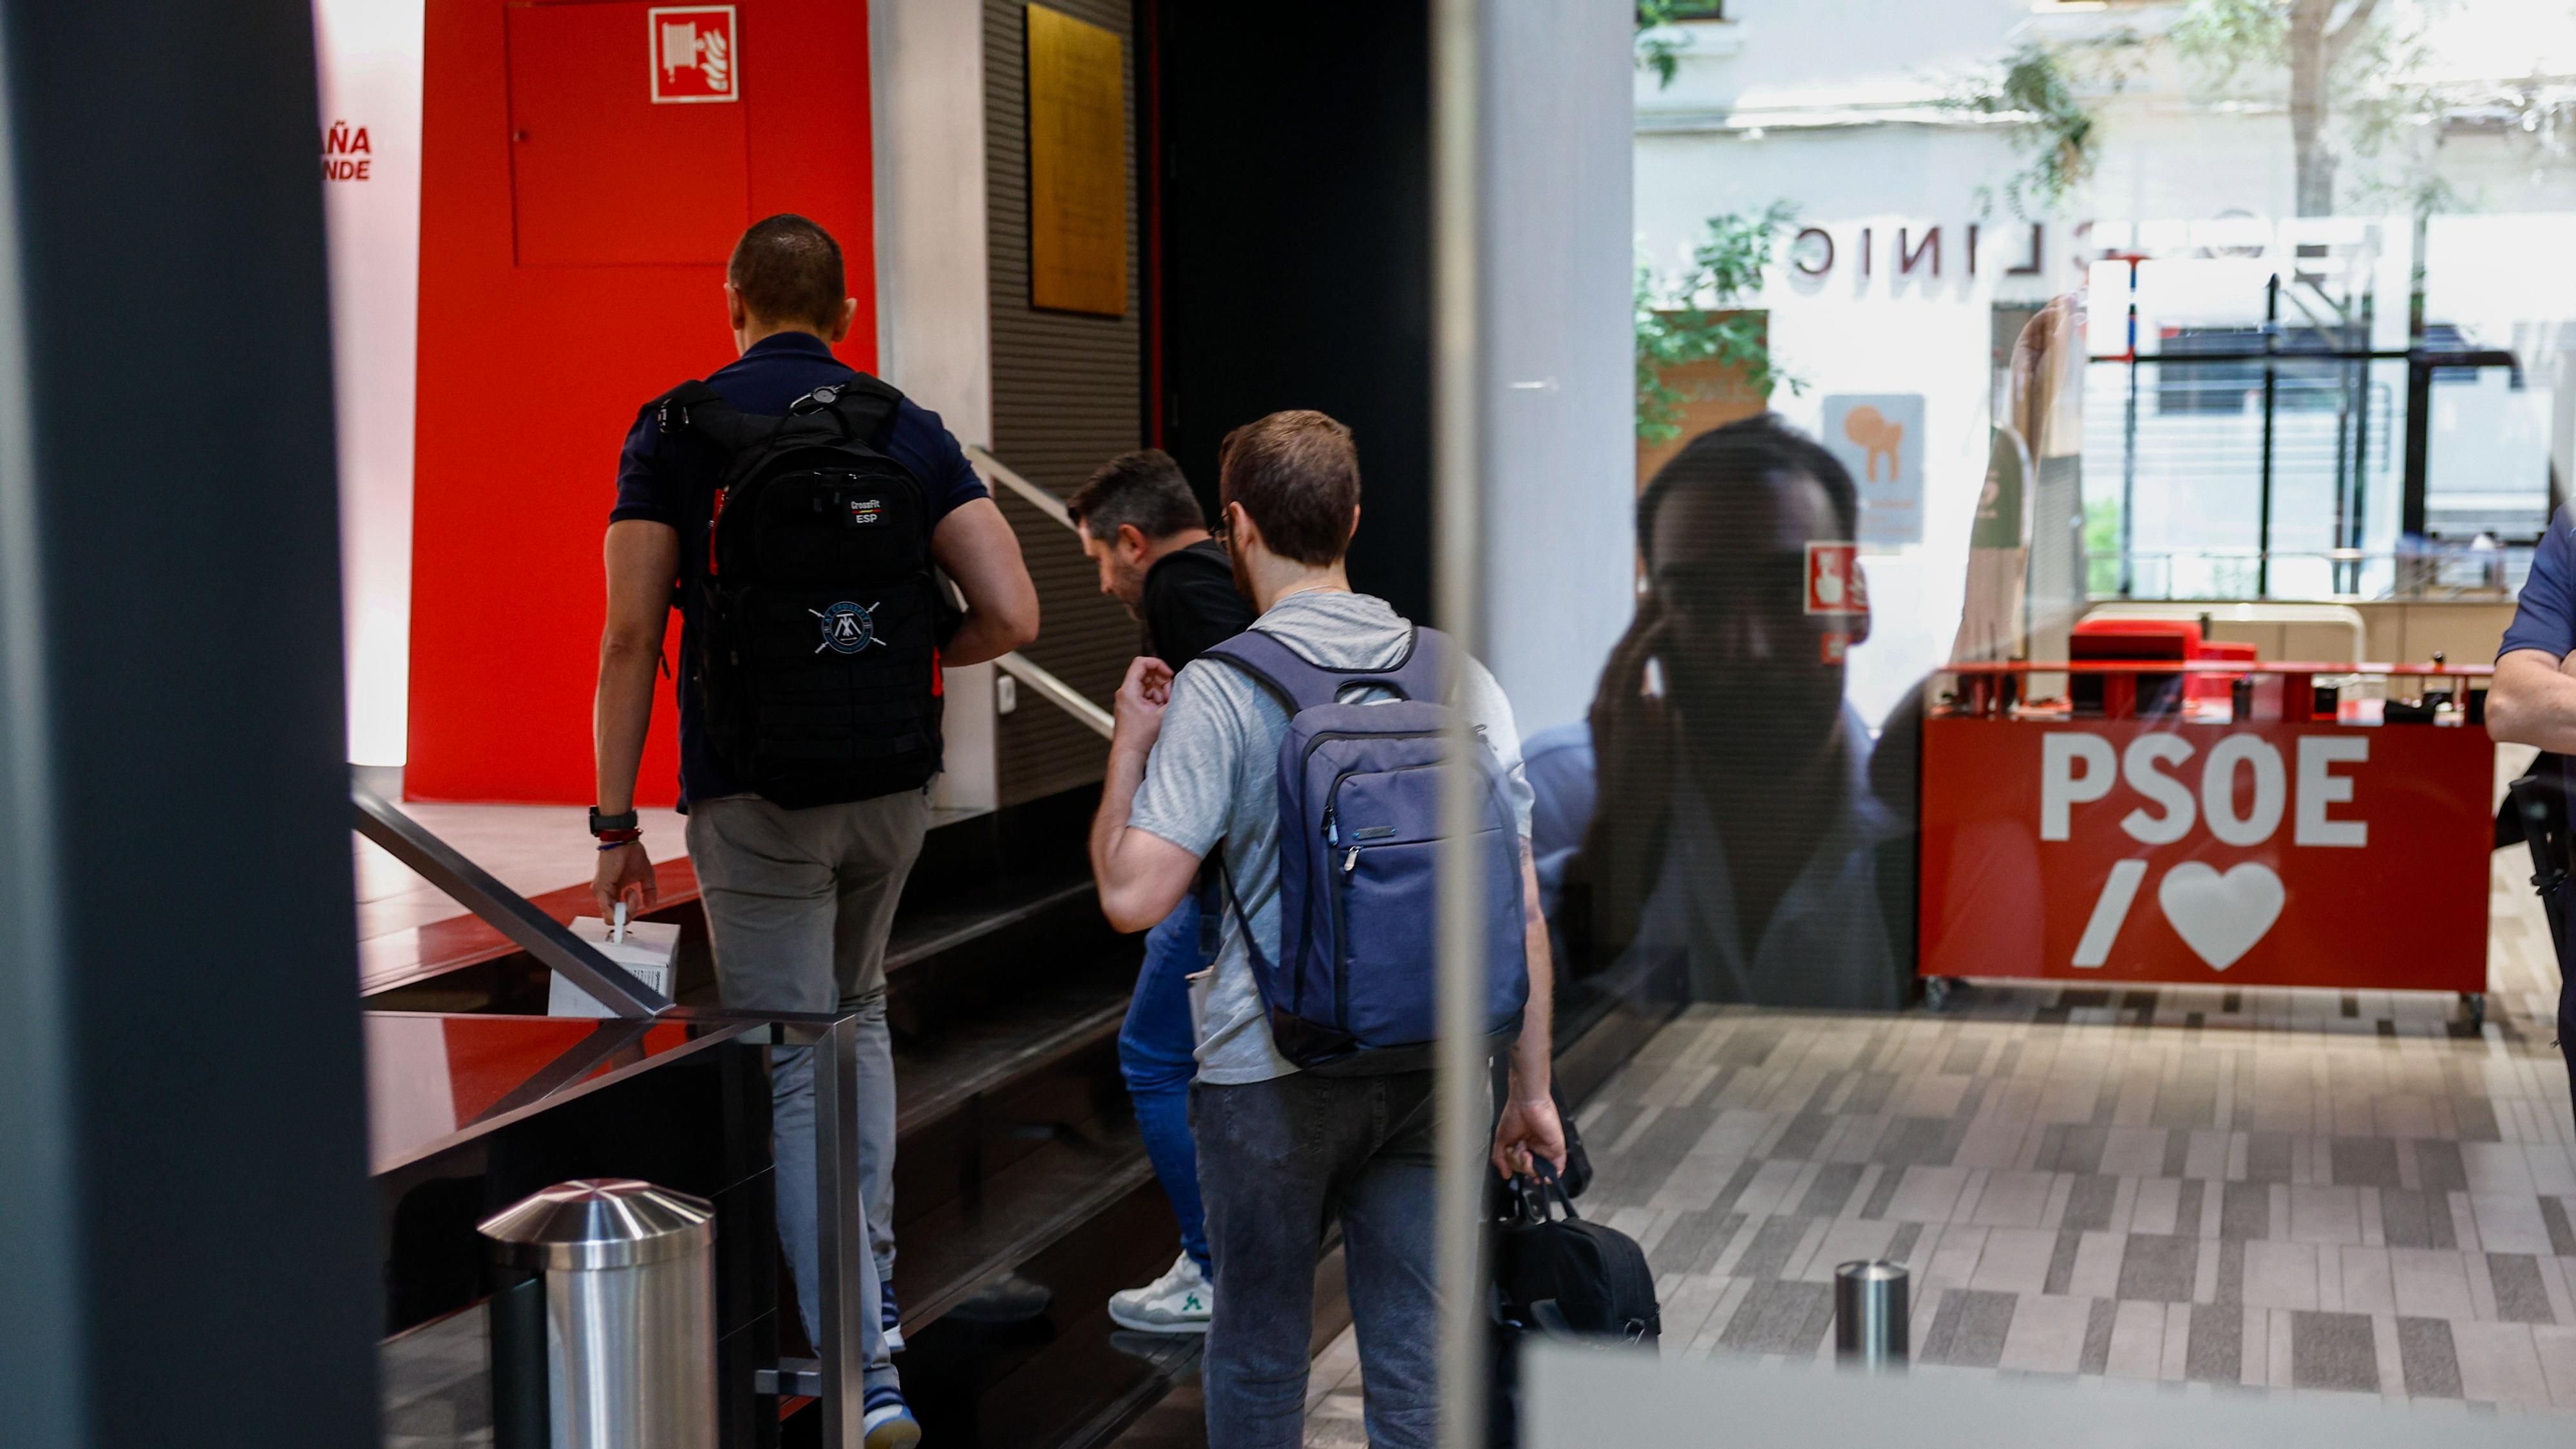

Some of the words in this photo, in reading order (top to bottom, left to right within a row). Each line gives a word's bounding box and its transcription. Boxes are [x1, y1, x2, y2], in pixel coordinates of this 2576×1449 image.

[320, 120, 371, 153] ÑA
[850, 499, 880, 509] CrossFit
[856, 513, 877, 524] ESP
[2040, 732, 2369, 848] PSOE
